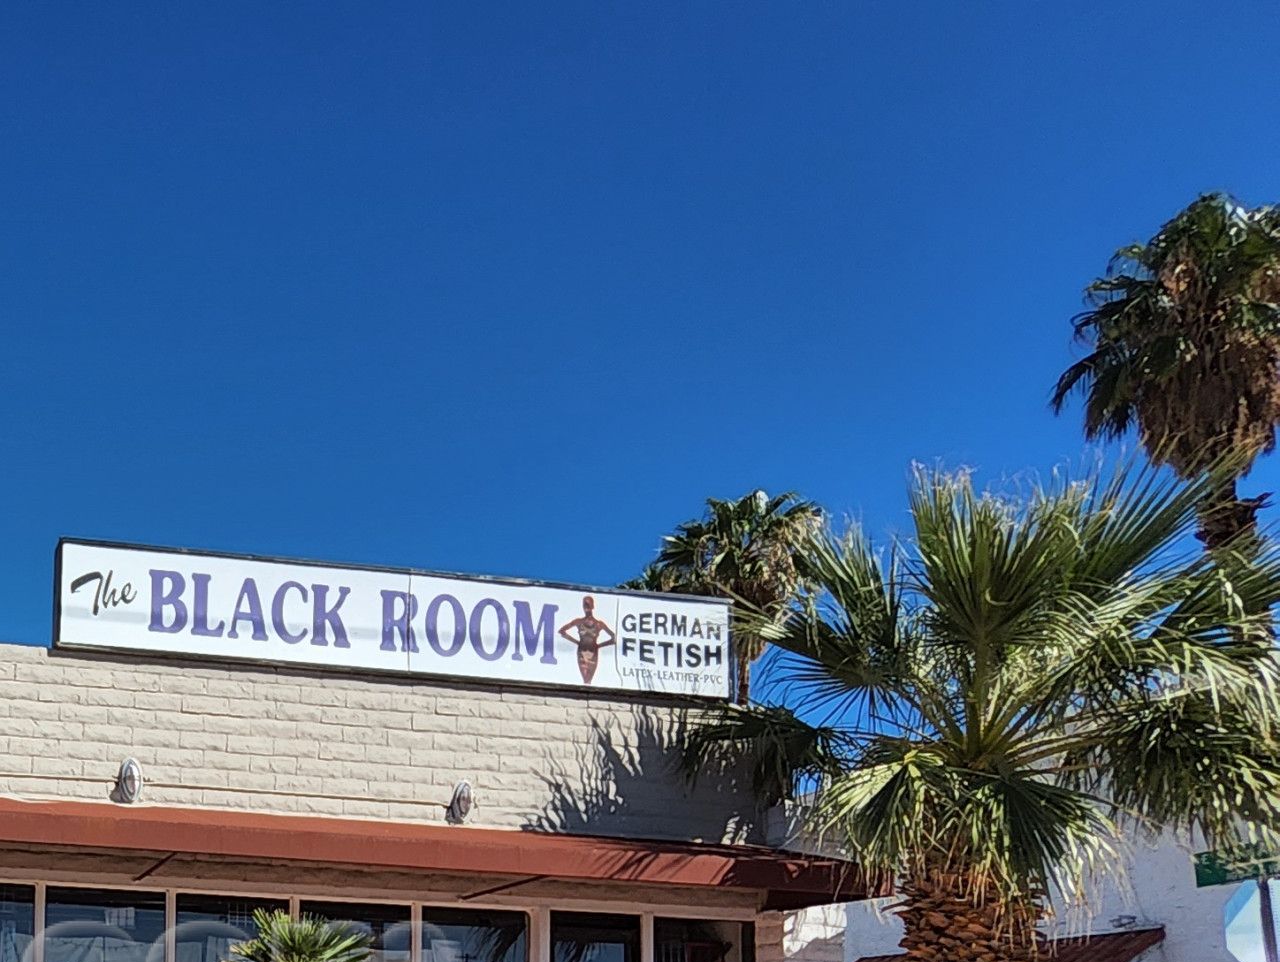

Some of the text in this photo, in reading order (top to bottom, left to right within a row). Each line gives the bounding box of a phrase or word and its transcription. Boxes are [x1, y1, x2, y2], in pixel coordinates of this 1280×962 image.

[70, 568, 558, 666] The BLACK ROOM
[621, 612, 723, 641] GERMAN
[621, 637, 722, 668] FETISH
